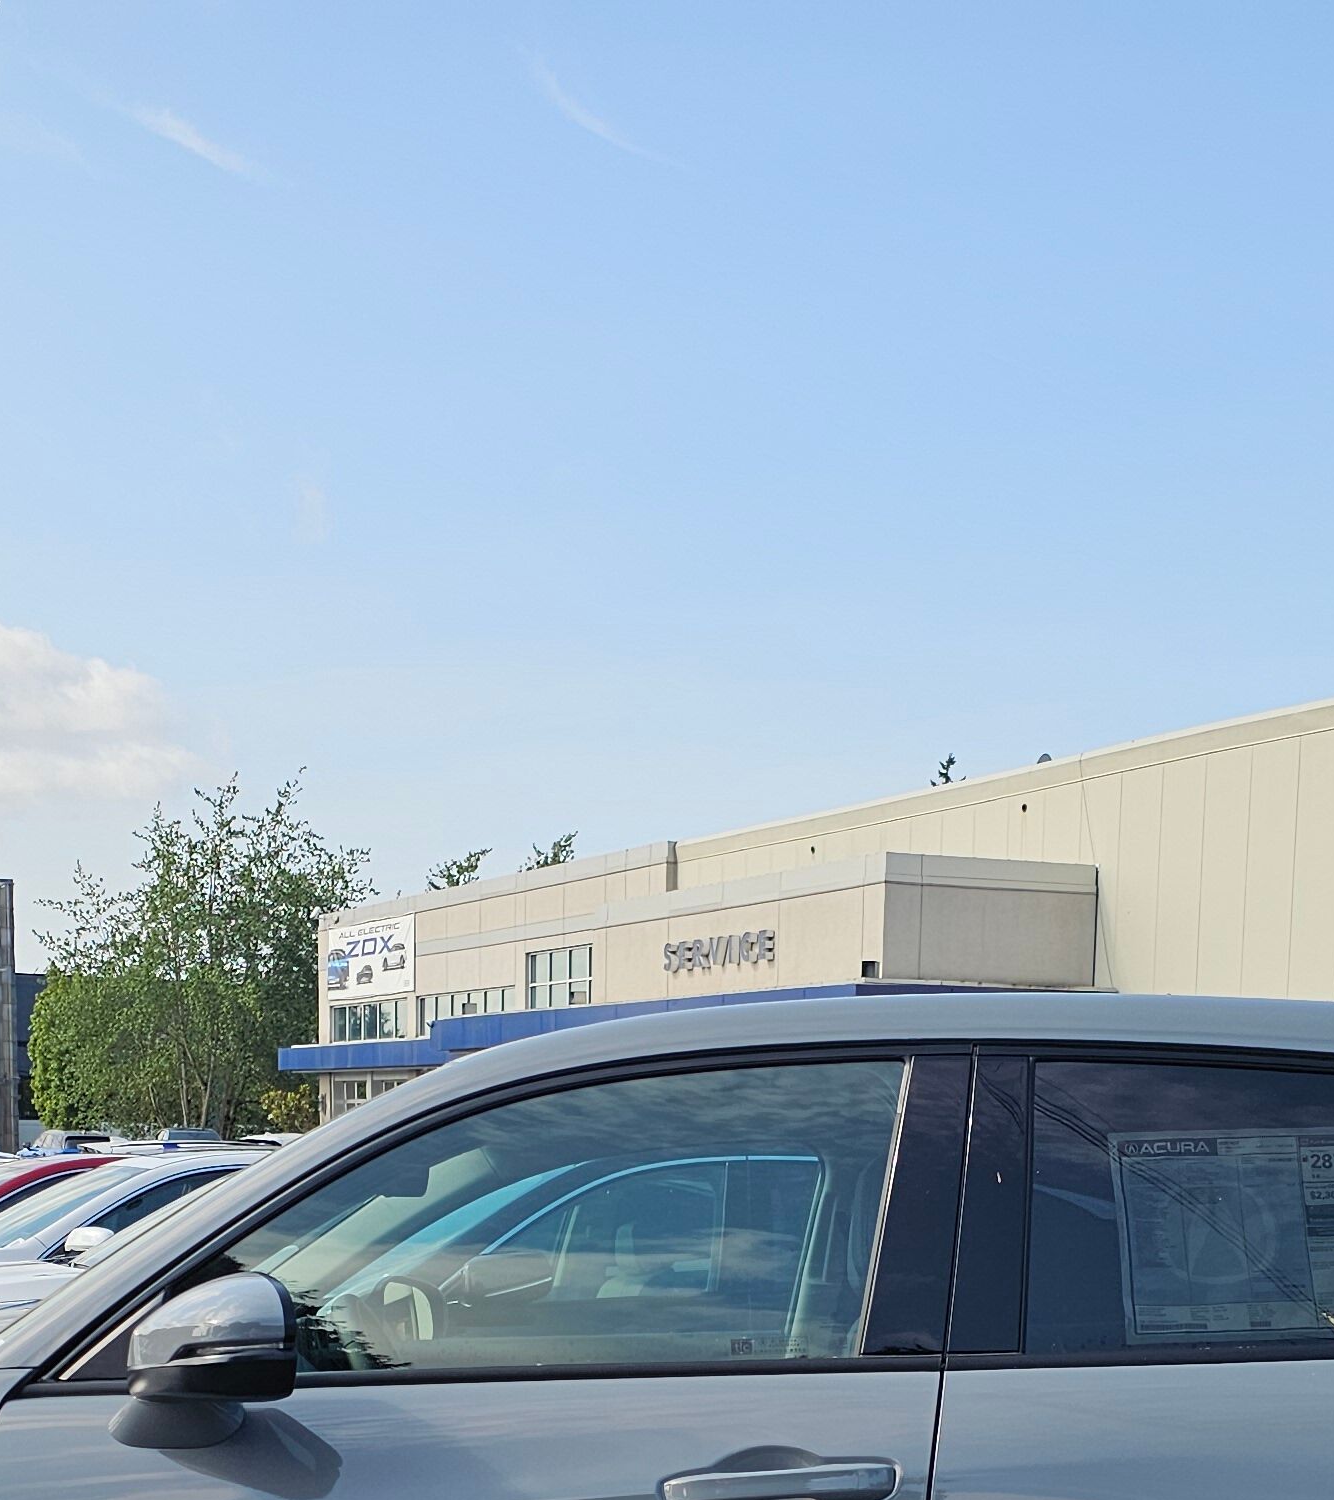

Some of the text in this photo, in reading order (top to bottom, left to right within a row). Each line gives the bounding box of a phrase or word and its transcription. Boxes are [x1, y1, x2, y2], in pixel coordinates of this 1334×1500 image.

[339, 922, 400, 939] ALL ELECTRIC
[664, 930, 775, 973] SERVICE
[1140, 1141, 1209, 1155] ACURA
[1310, 1154, 1333, 1169] 28
